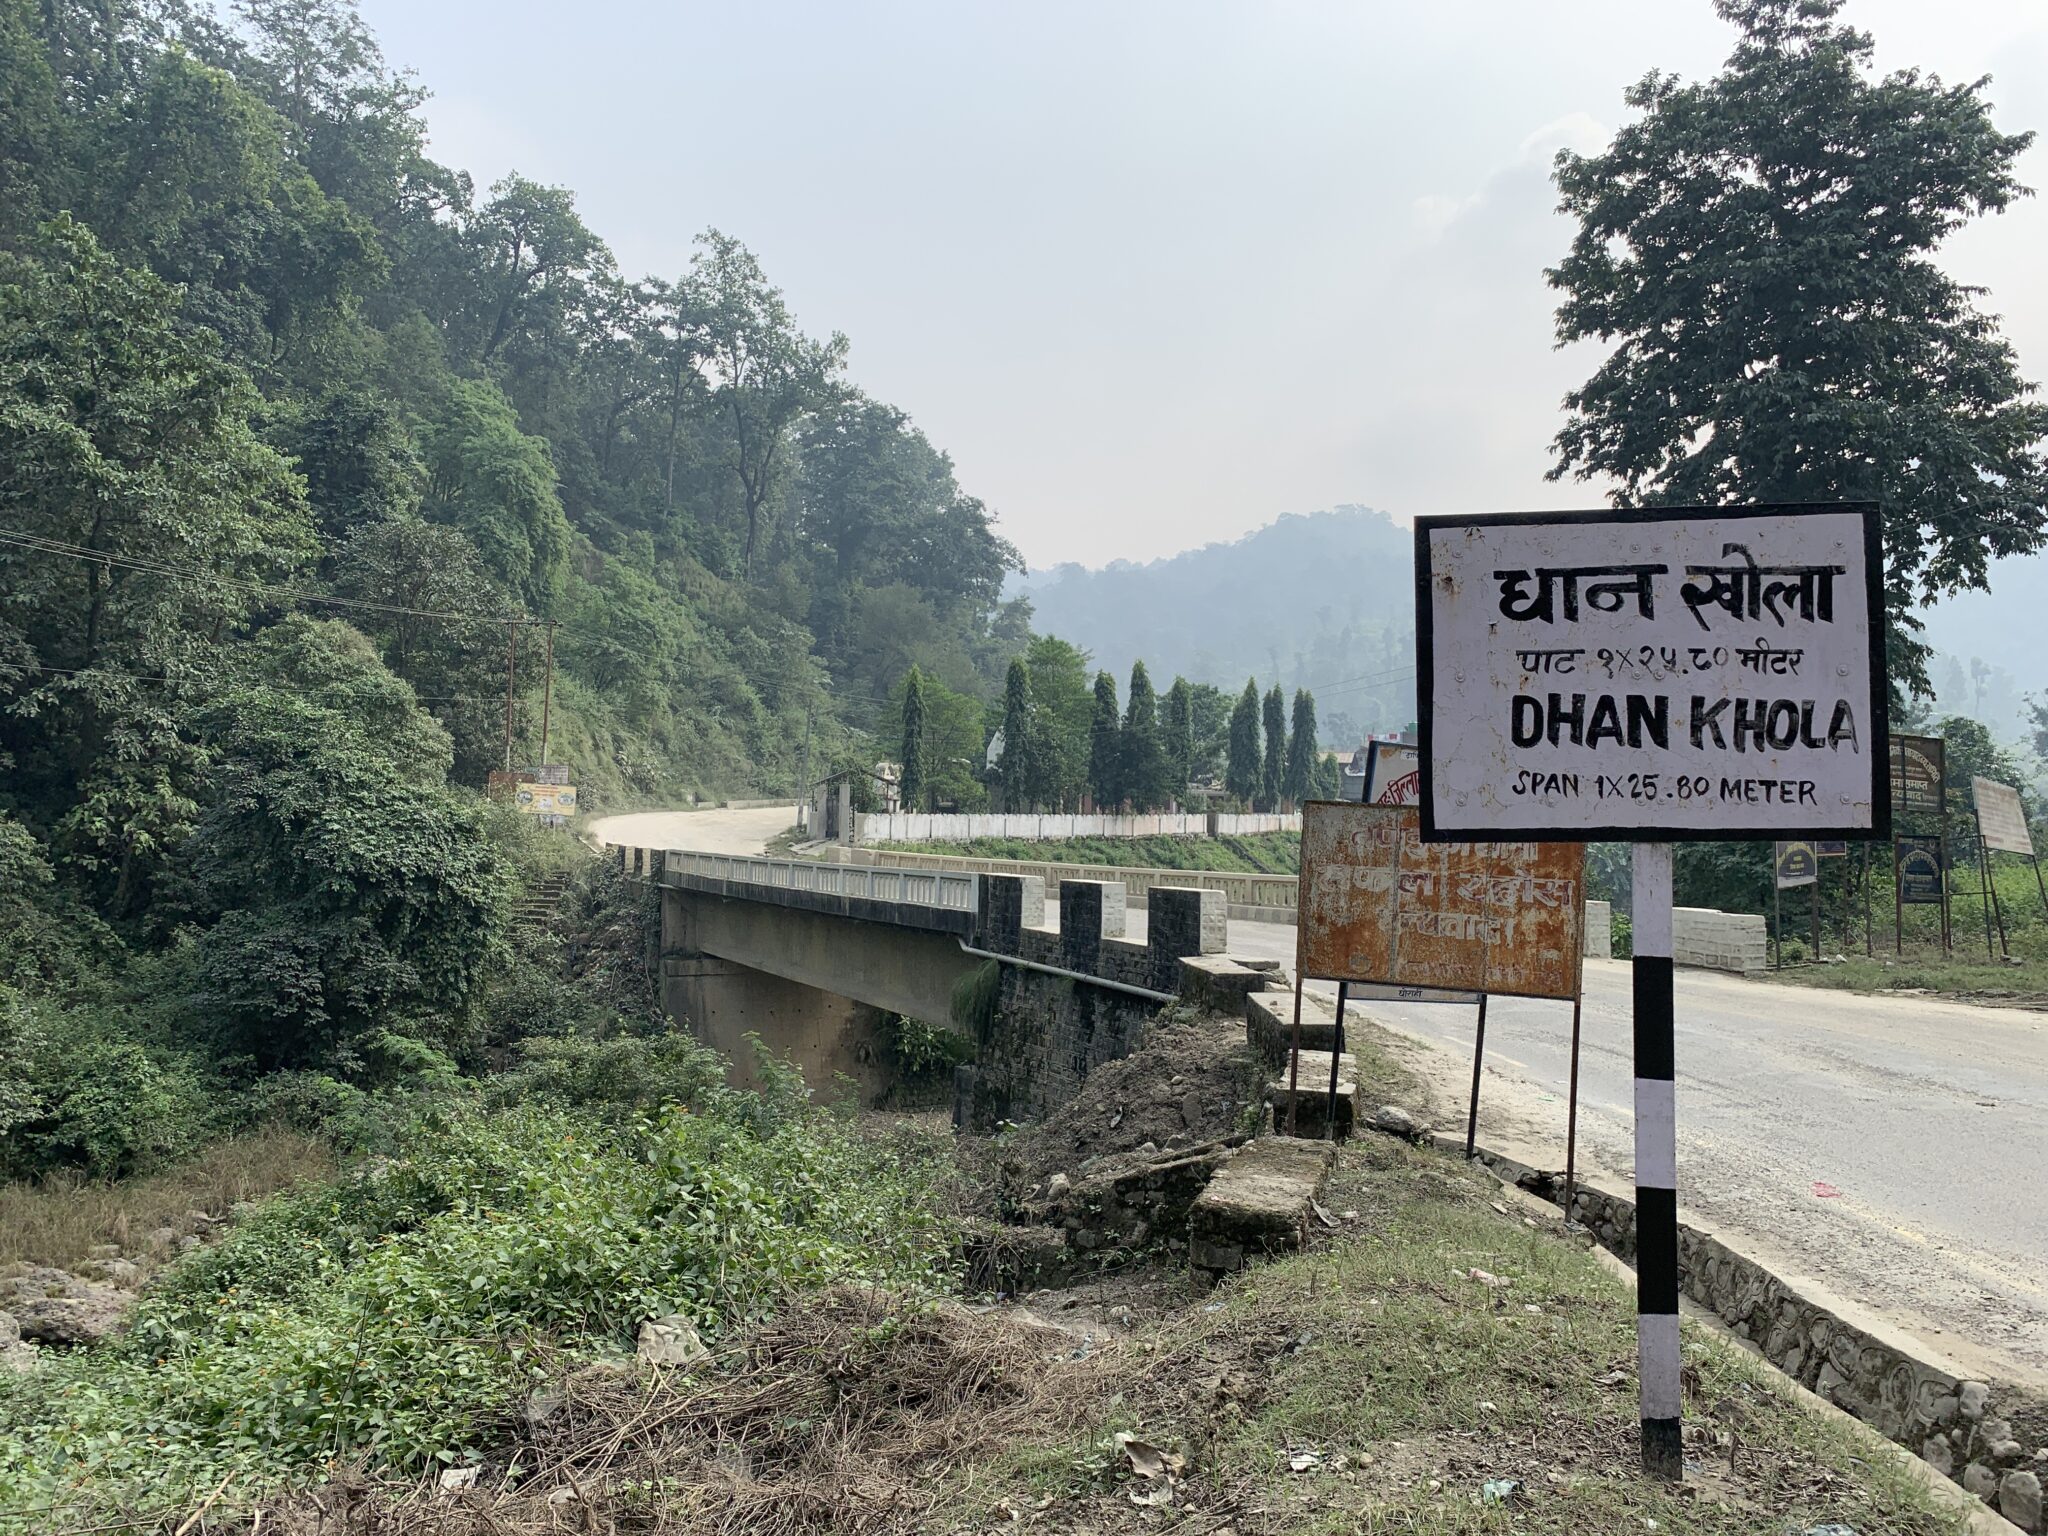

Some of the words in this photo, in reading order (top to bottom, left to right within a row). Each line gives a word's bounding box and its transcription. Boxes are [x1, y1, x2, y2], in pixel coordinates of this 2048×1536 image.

[1493, 563, 1669, 624] धान
[1680, 542, 1847, 632] खोला
[1516, 648, 1586, 675] पाट
[1735, 636, 1805, 676] मीटर
[1511, 692, 1670, 750] DHAN
[1690, 695, 1860, 754] KHOLA
[1511, 770, 1579, 798] SPAN
[1719, 779, 1818, 806] METER
